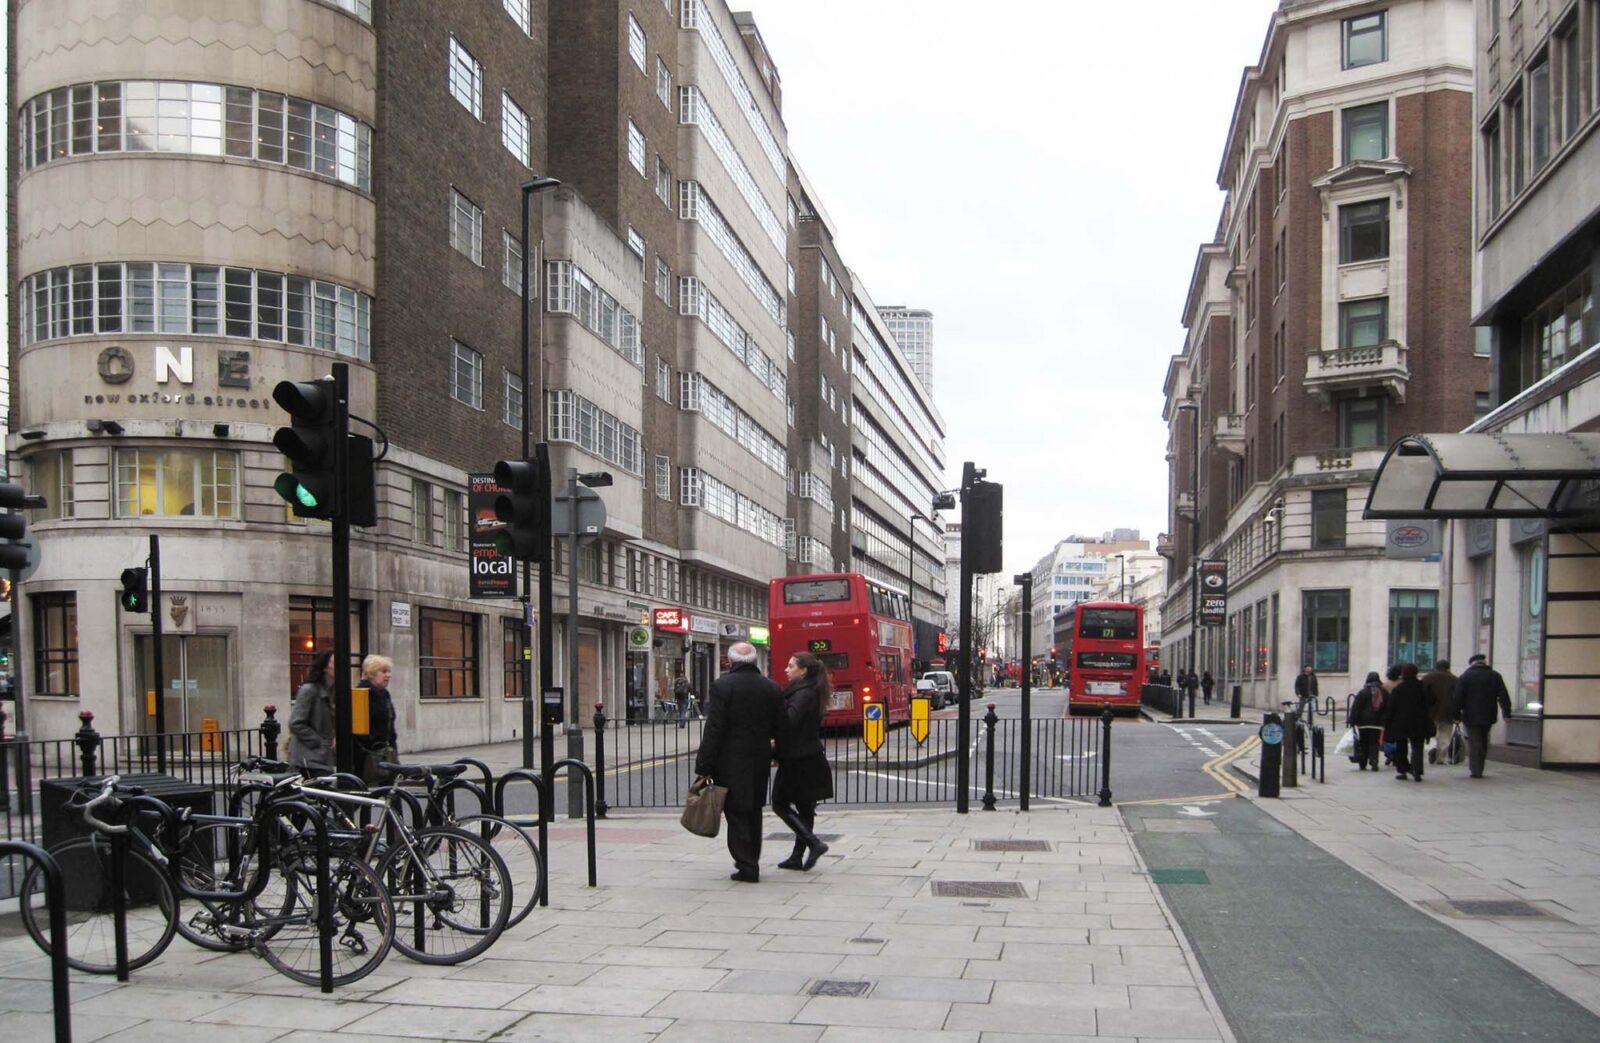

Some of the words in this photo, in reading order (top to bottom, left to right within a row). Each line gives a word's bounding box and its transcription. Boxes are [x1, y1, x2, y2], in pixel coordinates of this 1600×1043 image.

[98, 346, 251, 390] ONE
[84, 393, 120, 404] new
[127, 391, 195, 405] oxford
[203, 395, 270, 409] street
[473, 556, 512, 575] local
[656, 611, 679, 620] CAFE
